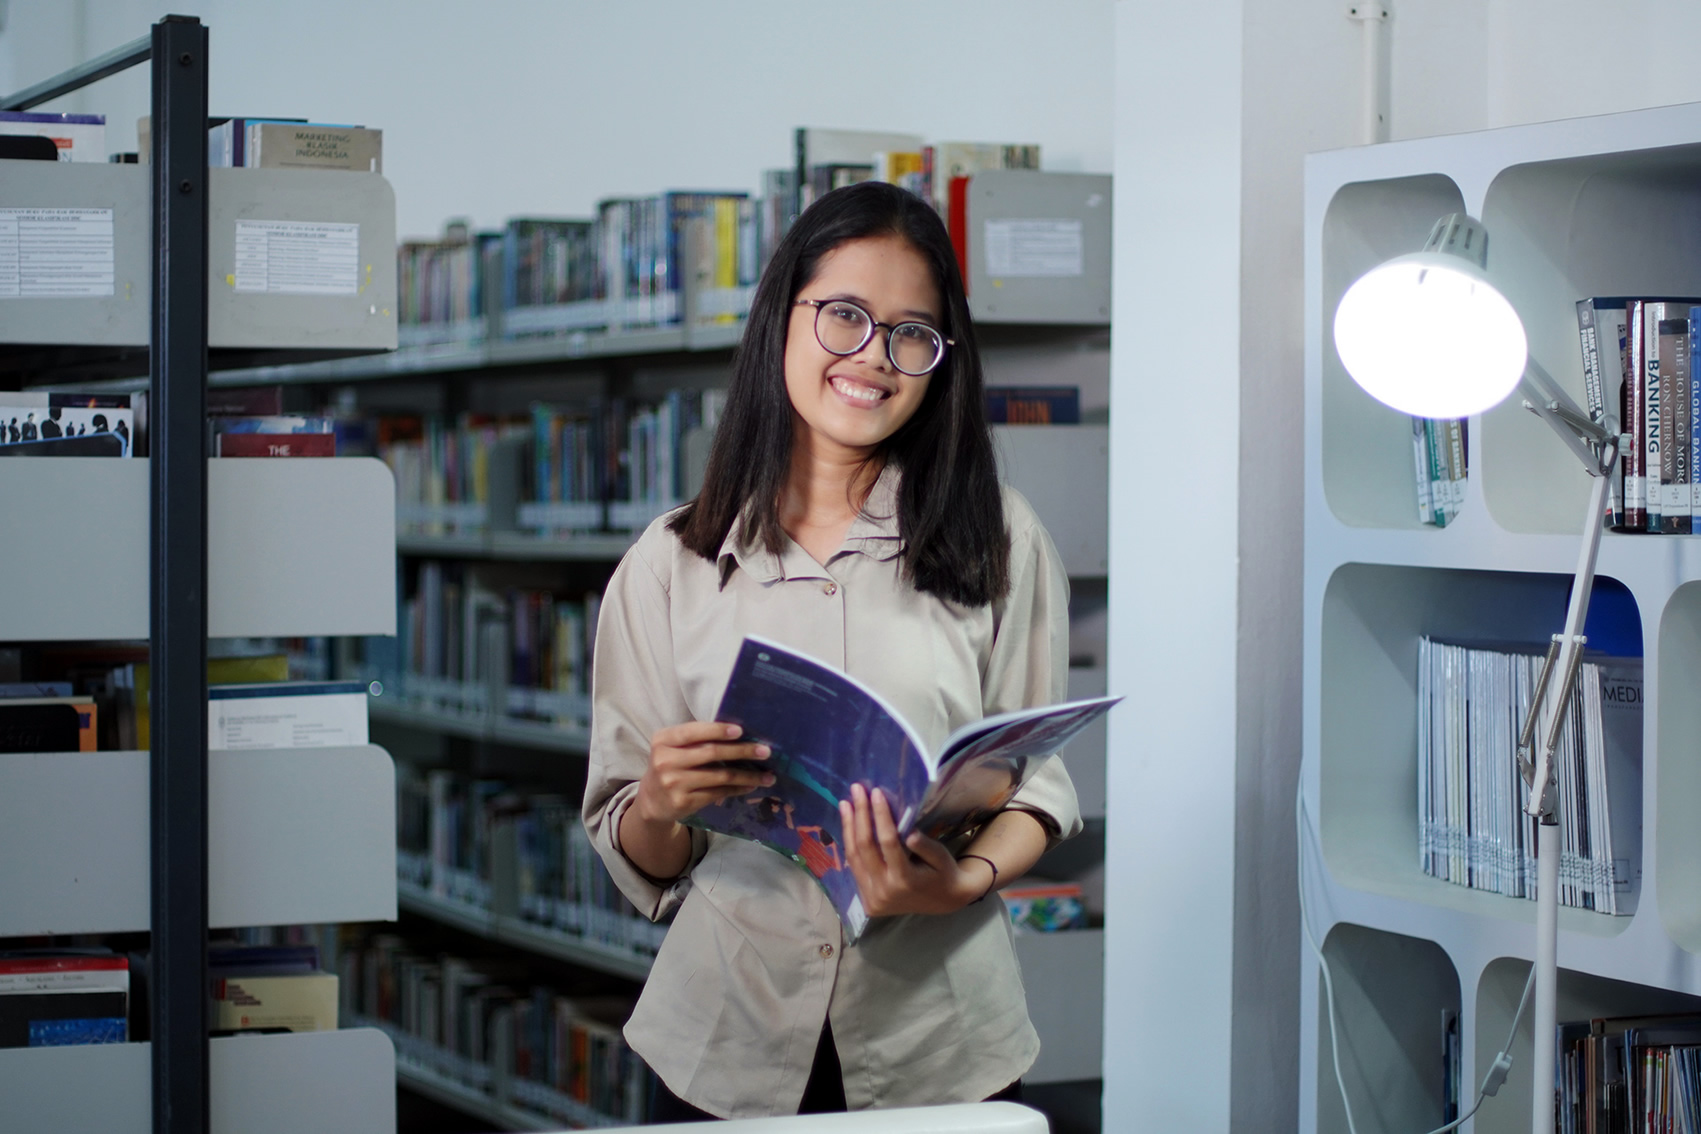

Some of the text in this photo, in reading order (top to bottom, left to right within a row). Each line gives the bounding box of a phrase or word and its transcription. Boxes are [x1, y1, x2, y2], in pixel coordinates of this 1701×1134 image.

[295, 132, 350, 143] MARKETING
[295, 149, 349, 159] INDONESIA
[1587, 327, 1596, 351] BANK
[1676, 337, 1684, 367] THE
[1580, 328, 1596, 412] FINANCIAL SERVICES
[1590, 351, 1602, 408] MANAGEMENT
[1648, 360, 1660, 453] BANKING
[1676, 371, 1684, 419] HOUSE
[1692, 381, 1700, 433] GLOBAL
[1663, 375, 1672, 475] RON CHERNOW
[1676, 422, 1685, 442] OF
[268, 444, 291, 456] THE
[1692, 438, 1700, 484] BANKIN
[1603, 686, 1643, 703] MEDI
